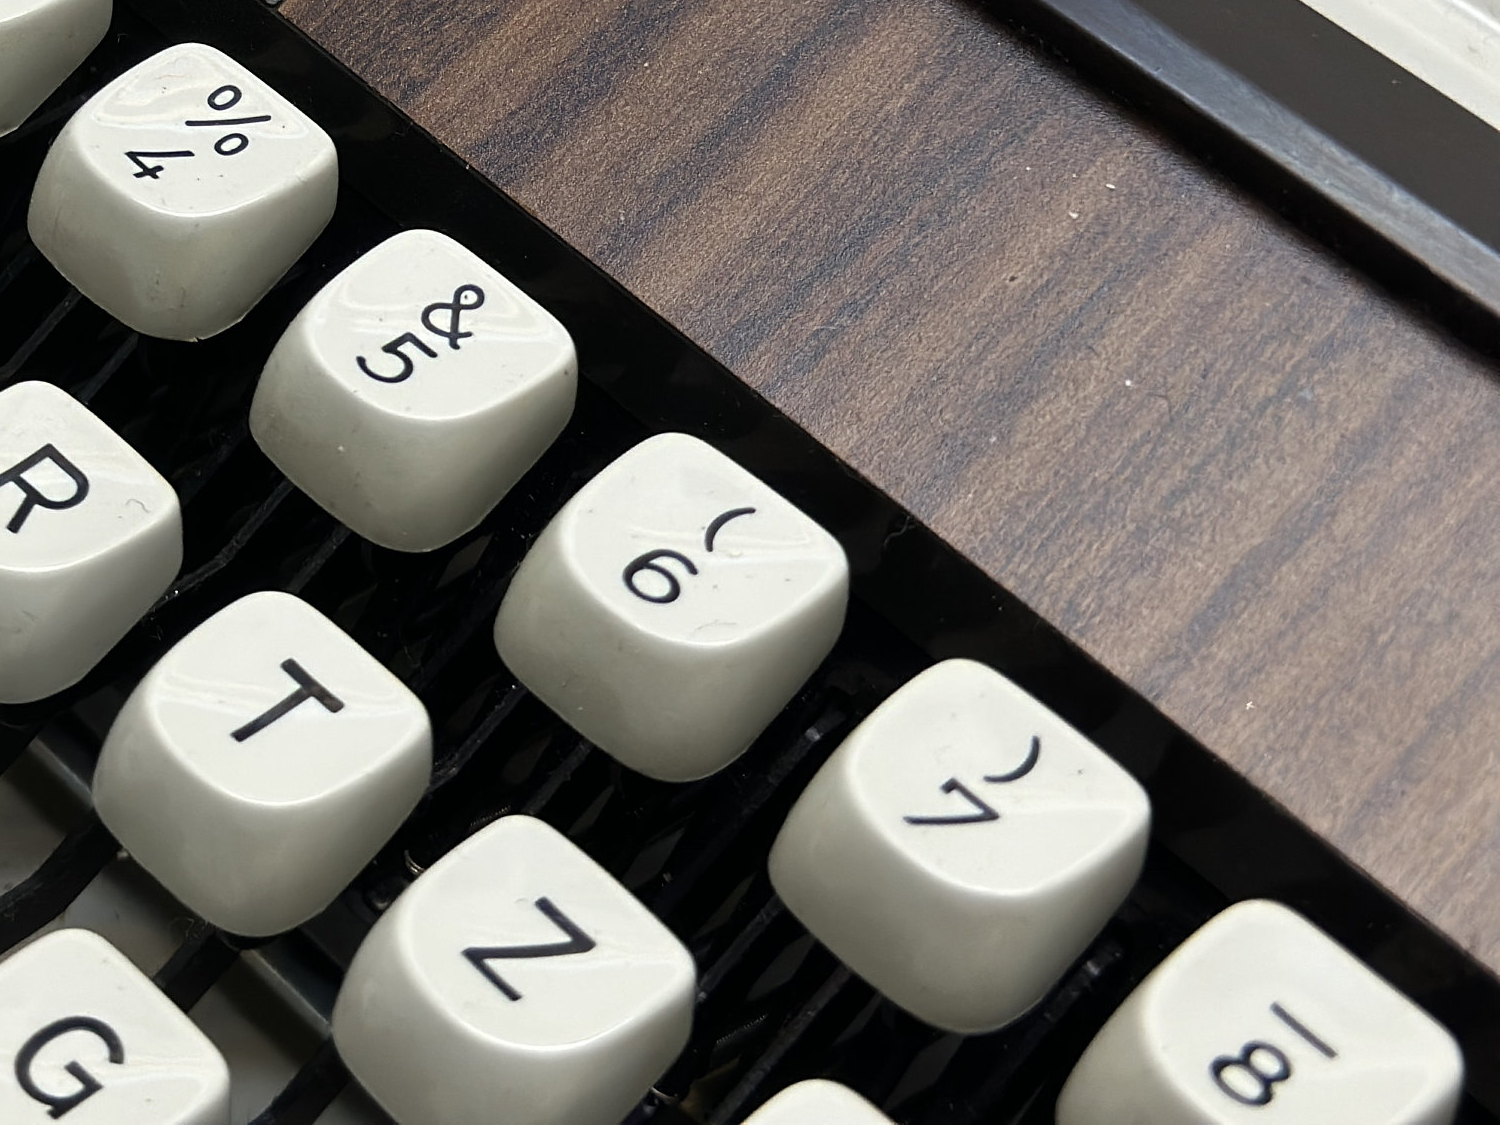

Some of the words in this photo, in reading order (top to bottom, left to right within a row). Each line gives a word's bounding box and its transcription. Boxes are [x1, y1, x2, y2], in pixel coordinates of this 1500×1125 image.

[183, 83, 273, 157] %
[123, 149, 196, 180] 4
[419, 283, 486, 351] &
[355, 331, 439, 385] 5
[621, 548, 700, 606] 6
[229, 657, 346, 744] T
[902, 776, 1001, 827] 7
[460, 896, 598, 1003] Z
[13, 1015, 125, 1121] G
[1208, 1039, 1294, 1109] 8
